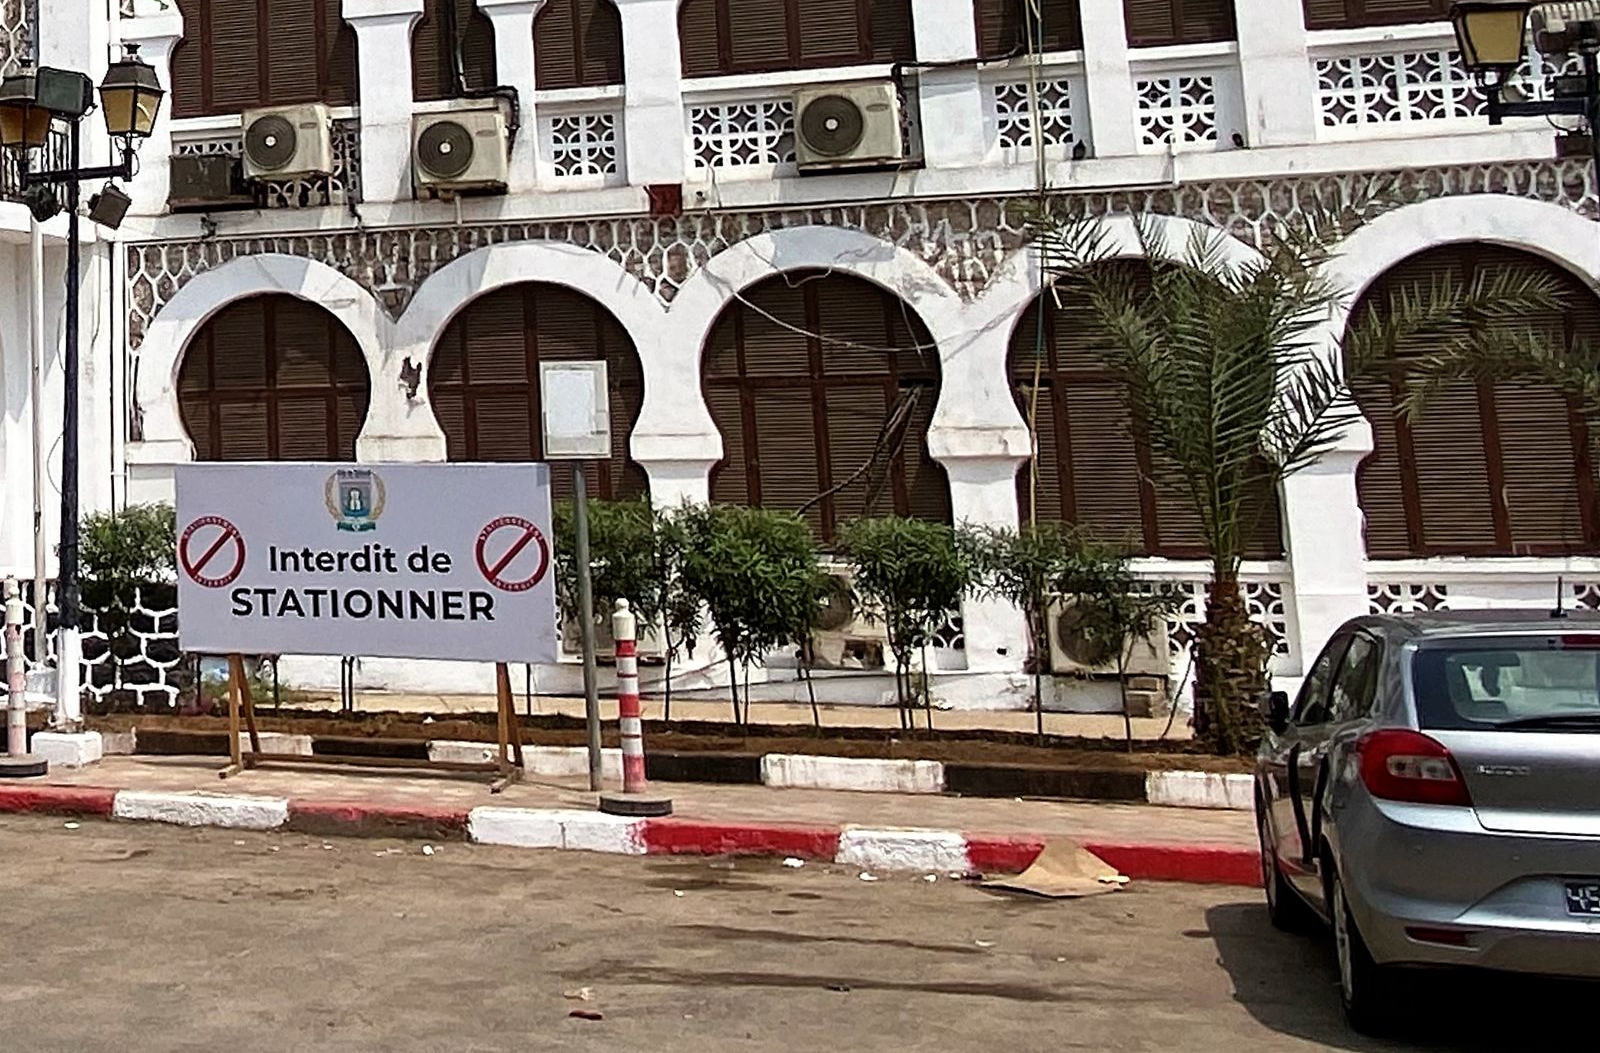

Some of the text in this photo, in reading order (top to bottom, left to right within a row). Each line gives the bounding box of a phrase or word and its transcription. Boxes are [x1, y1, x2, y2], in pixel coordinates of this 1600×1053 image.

[269, 544, 452, 574] Interdit de
[231, 588, 495, 621] STATIONNER
